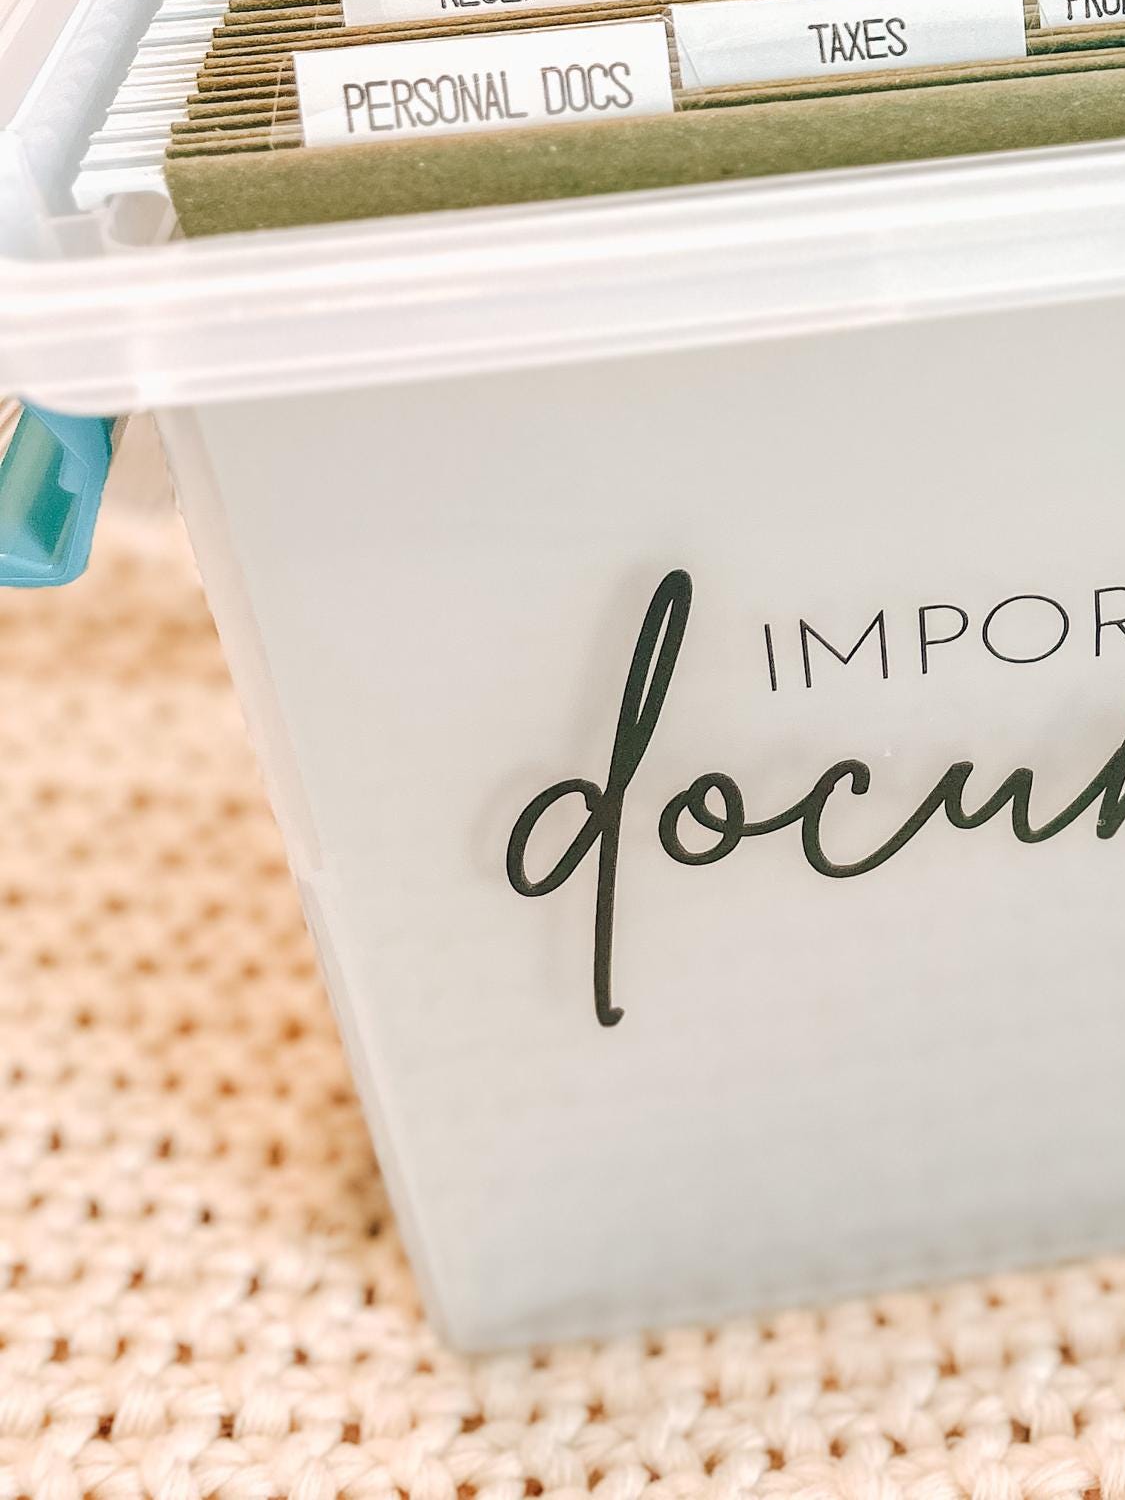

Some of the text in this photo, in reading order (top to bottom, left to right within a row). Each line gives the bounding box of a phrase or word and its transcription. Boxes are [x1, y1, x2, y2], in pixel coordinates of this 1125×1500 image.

[808, 17, 908, 64] TAXES
[343, 61, 634, 133] PERSONAL DOCS
